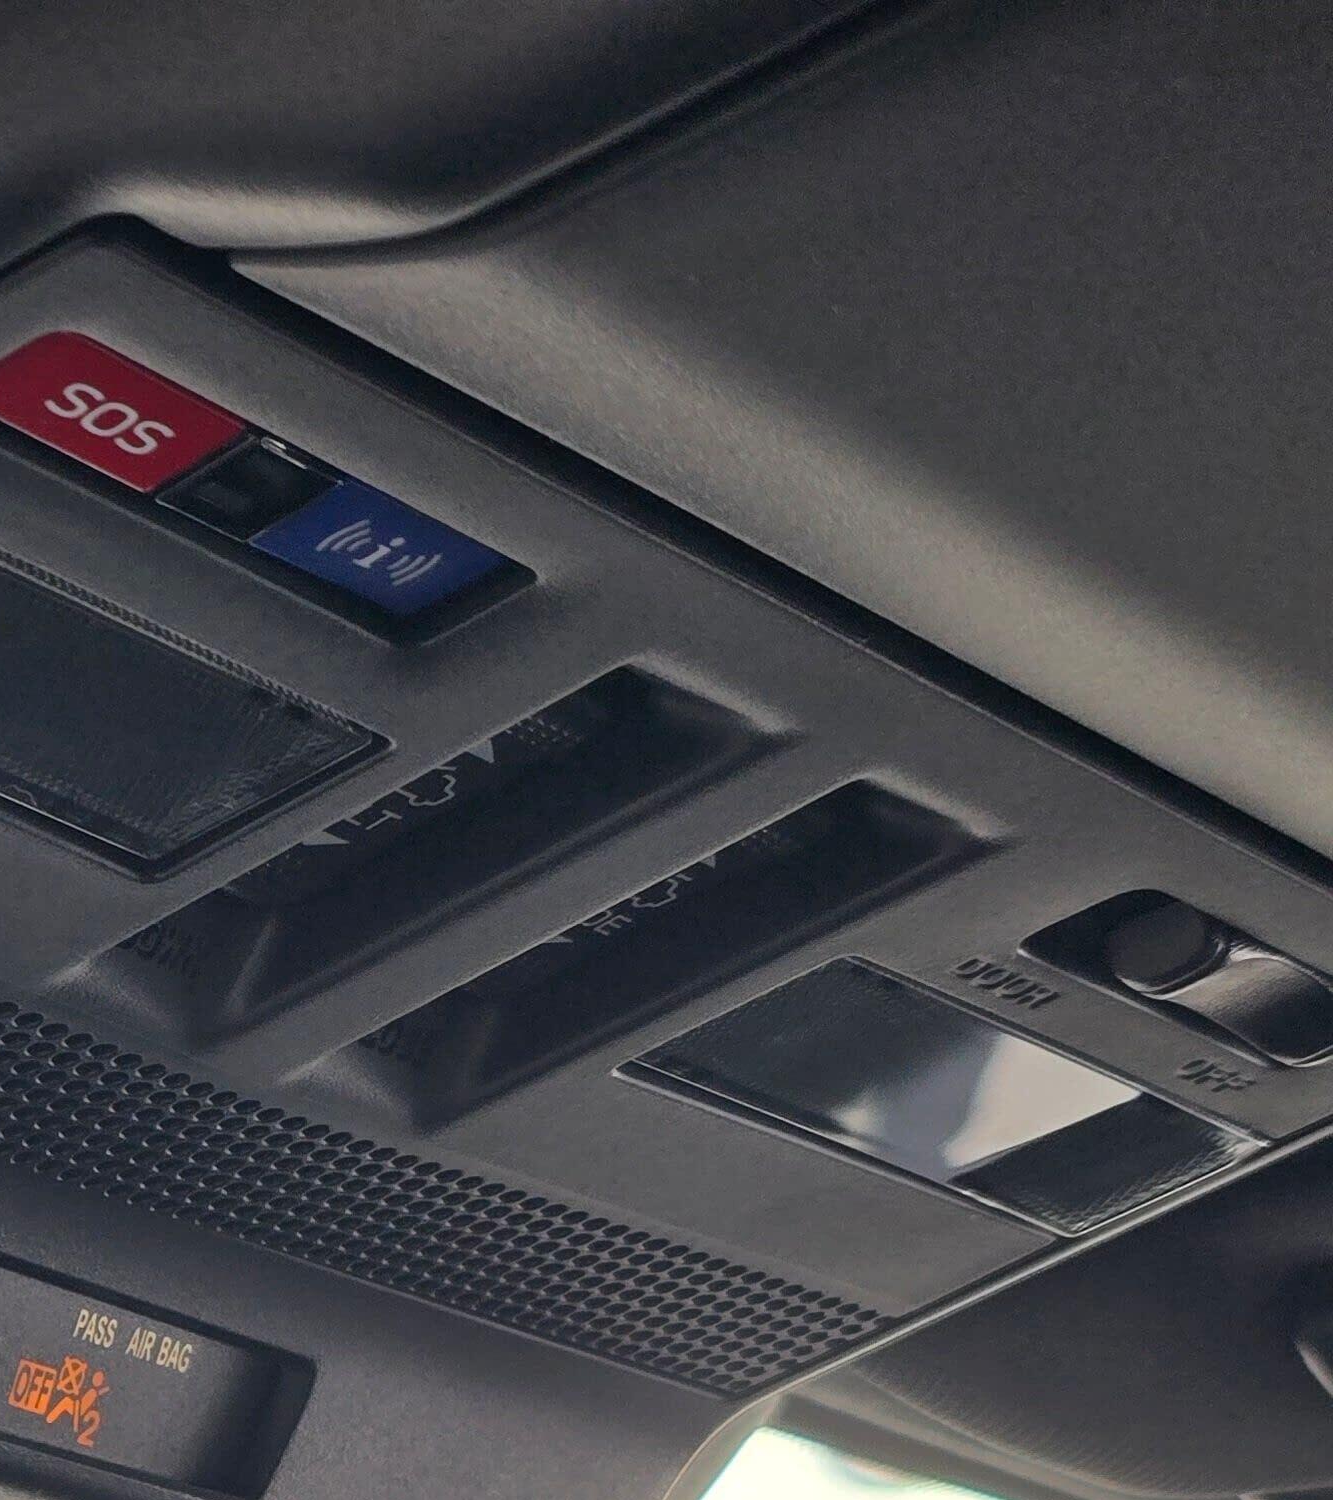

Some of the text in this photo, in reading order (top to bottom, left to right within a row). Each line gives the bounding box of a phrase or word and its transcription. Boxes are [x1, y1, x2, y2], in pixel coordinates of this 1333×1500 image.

[43, 382, 177, 455] SOS
[1177, 1057, 1255, 1093] OFF
[73, 1308, 193, 1373] PASS AIR BAG
[76, 1409, 101, 1447] 2
